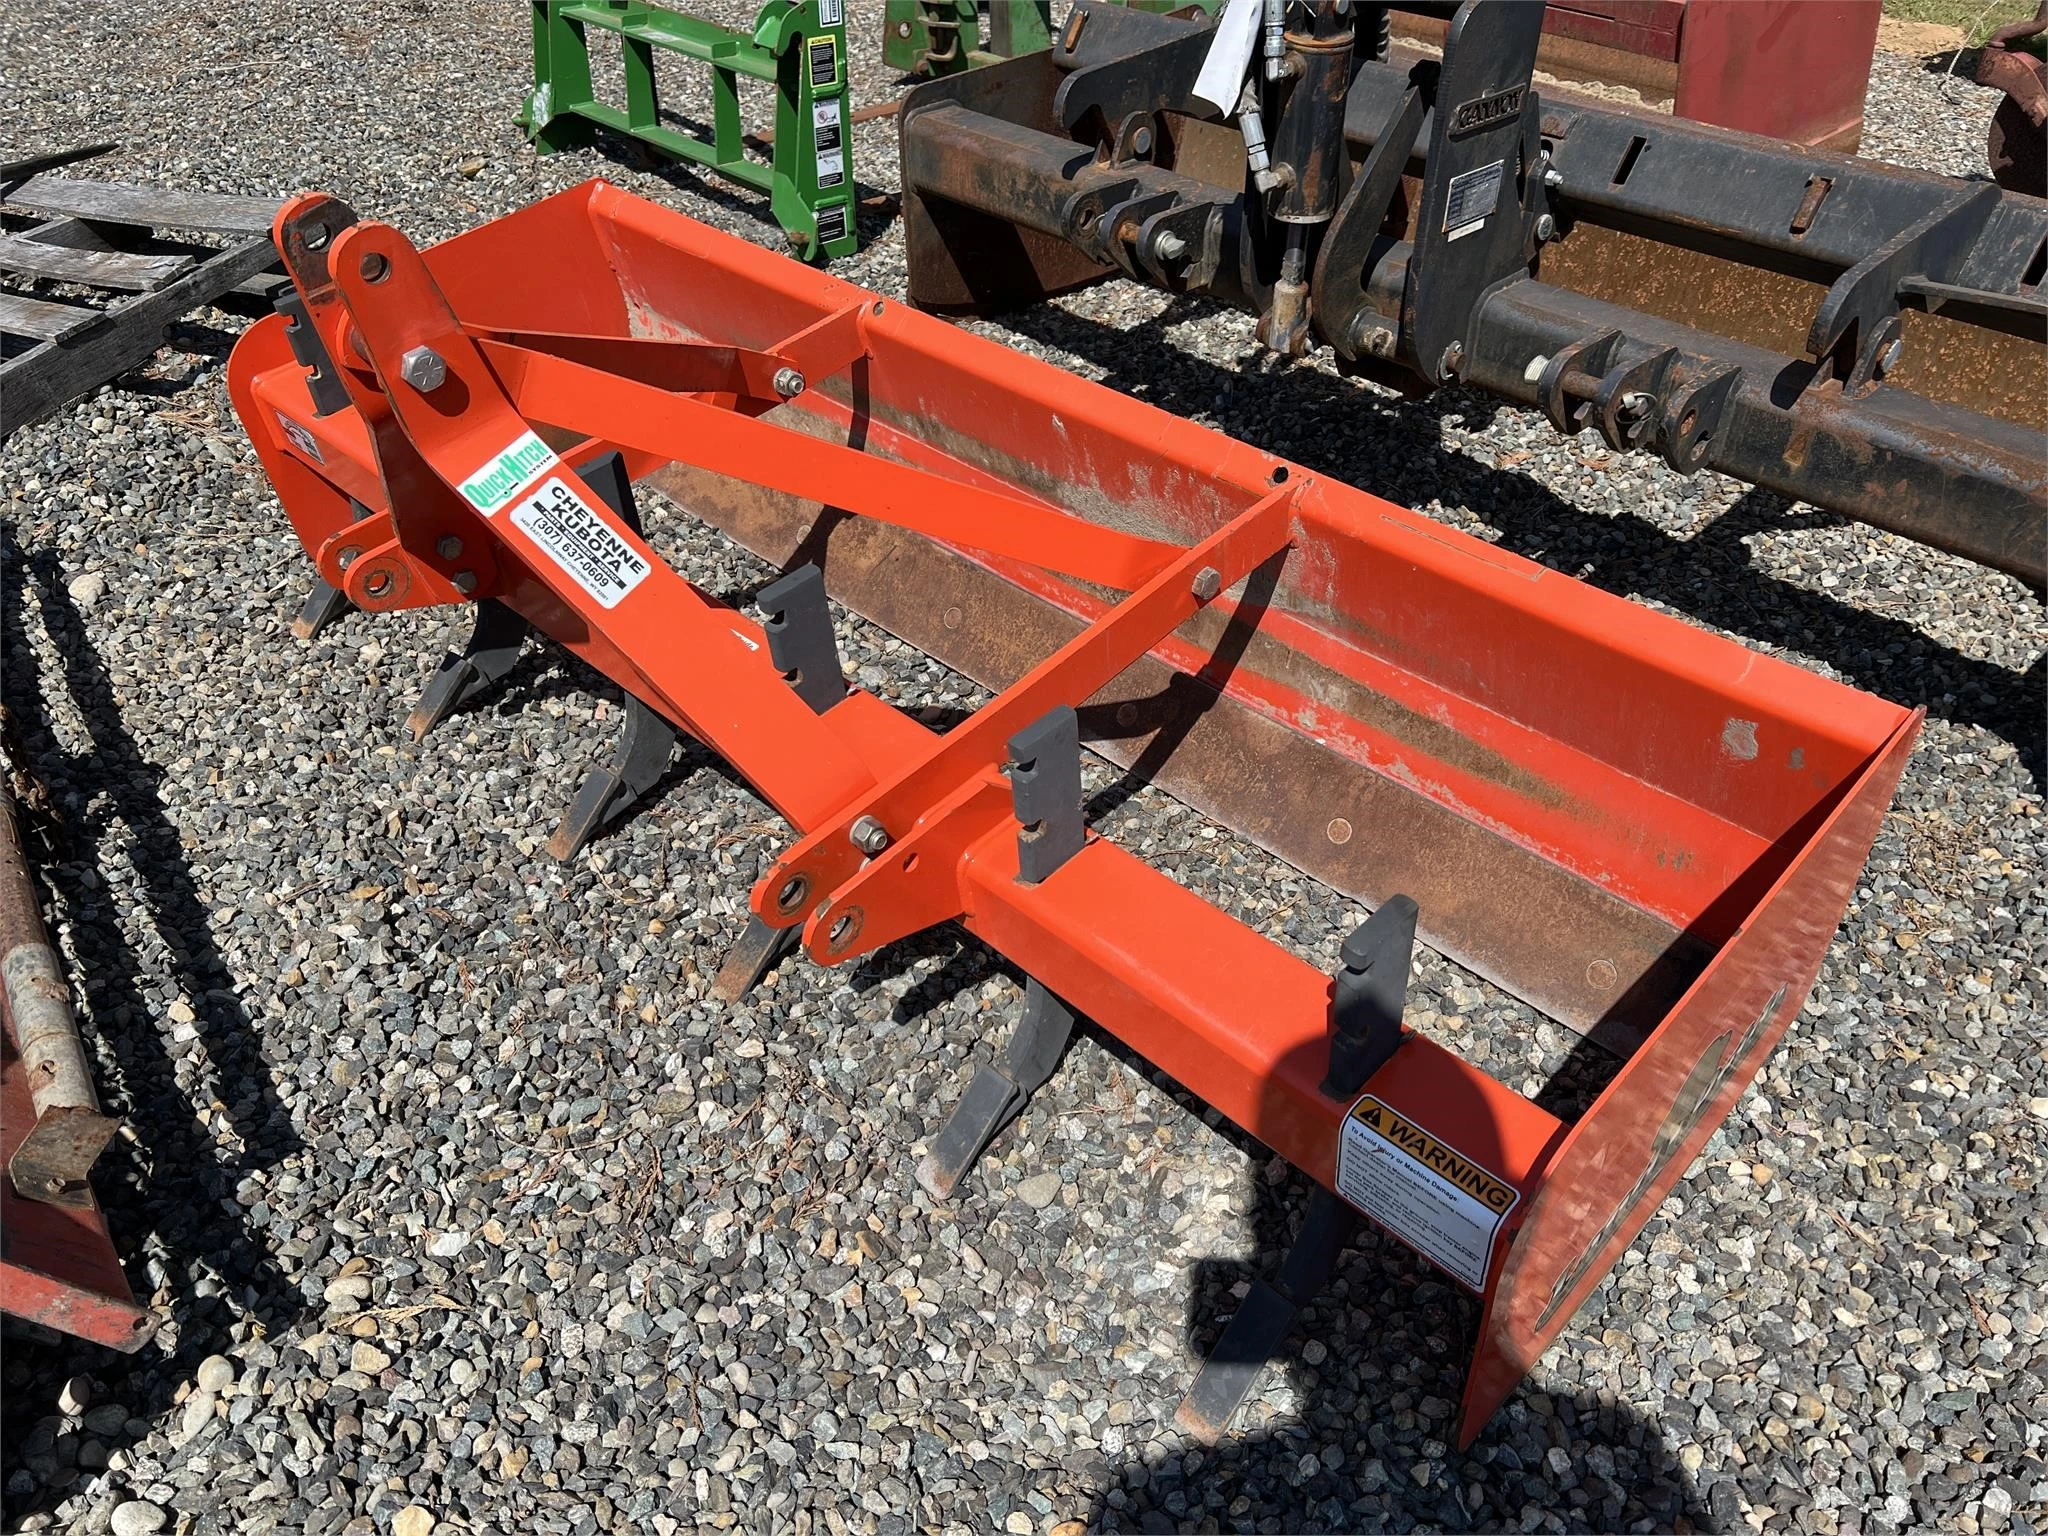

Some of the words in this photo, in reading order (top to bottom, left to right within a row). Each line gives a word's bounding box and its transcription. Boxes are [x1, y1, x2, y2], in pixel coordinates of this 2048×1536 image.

[528, 454, 553, 475] SYSTEM
[531, 516, 564, 546] (307)
[560, 541, 610, 588] 637-0609
[542, 510, 562, 528] PARTS
[562, 529, 595, 559] EQUIPMENT
[596, 561, 620, 583] SERVICE
[551, 503, 623, 573] KUBOTA
[552, 486, 645, 574] CHEYENNE
[1351, 1126, 1358, 1134] To
[1358, 1131, 1377, 1146] Avoid
[1403, 1161, 1431, 1182] Machine
[1388, 1120, 1508, 1207] WARNING
